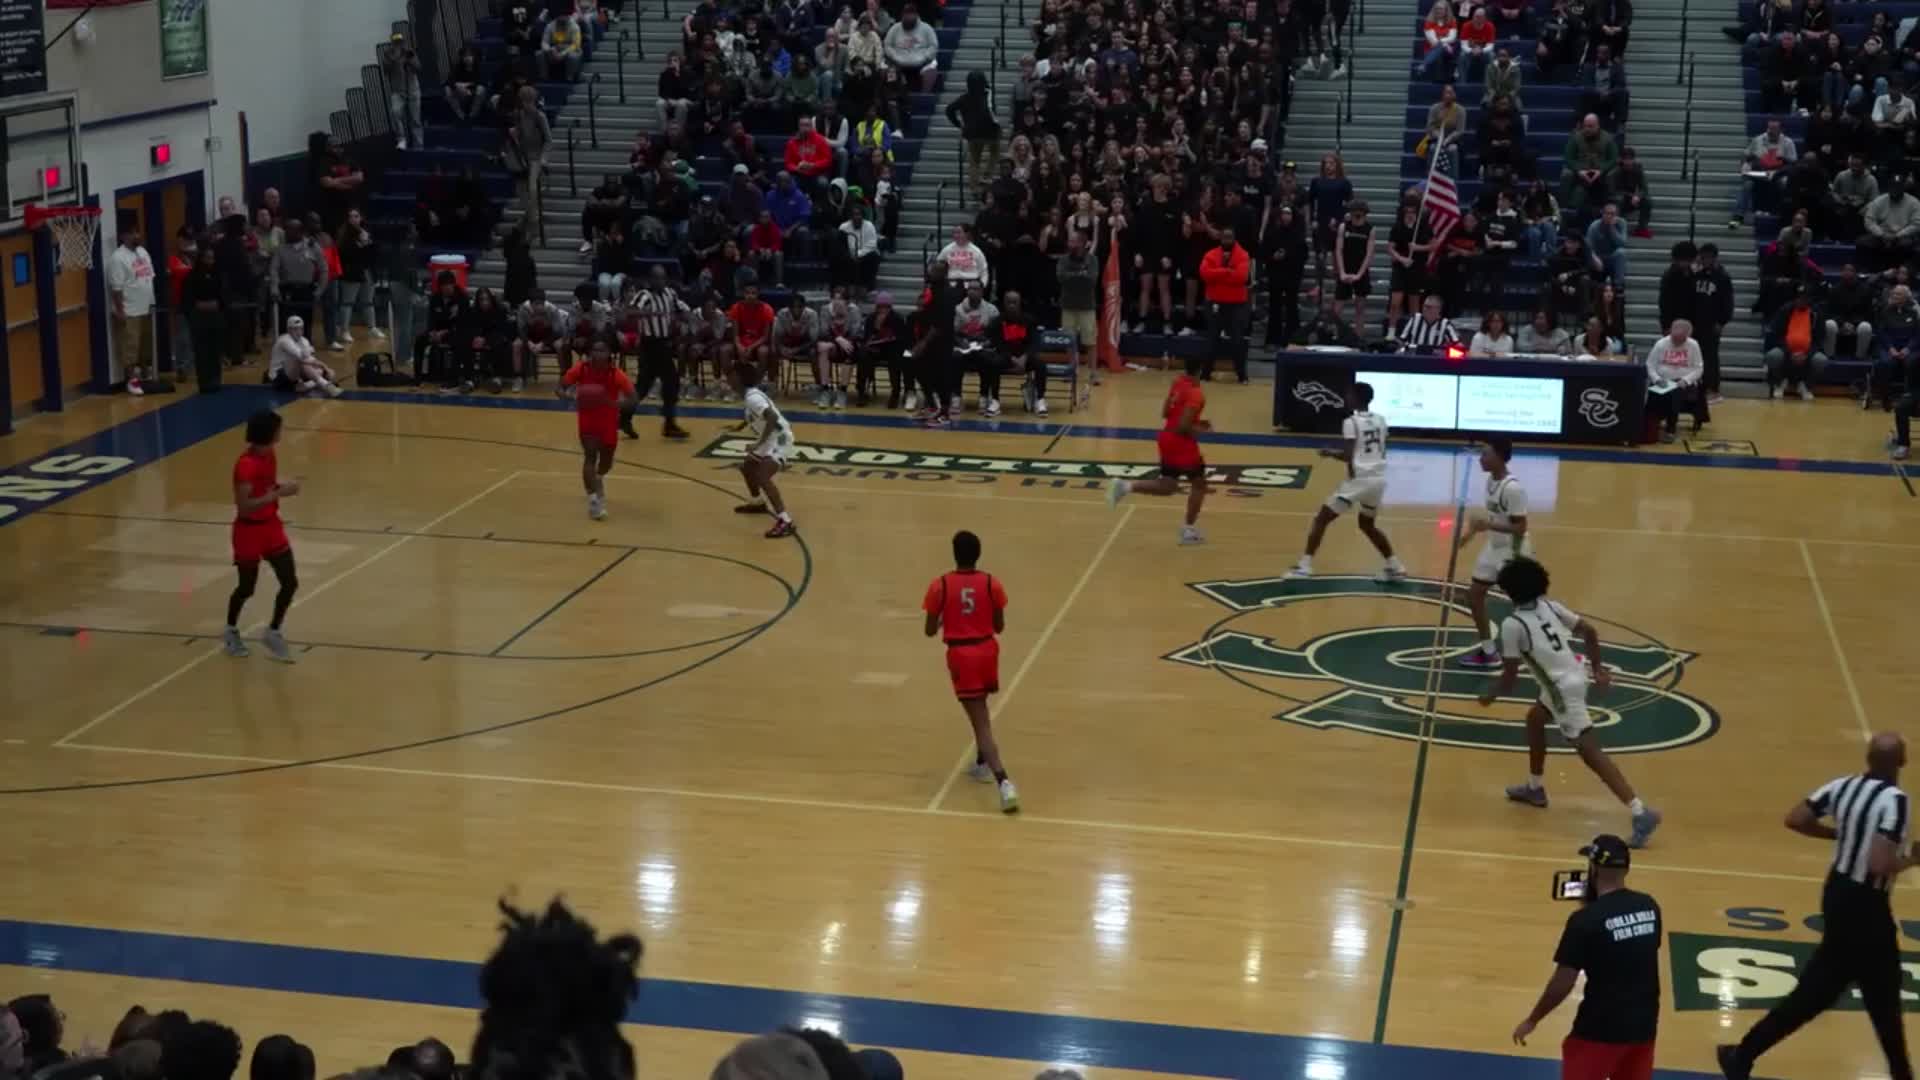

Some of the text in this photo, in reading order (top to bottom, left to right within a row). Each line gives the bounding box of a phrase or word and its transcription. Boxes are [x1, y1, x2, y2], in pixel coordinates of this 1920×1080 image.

[1020, 477, 1265, 498] STH
[960, 587, 977, 615] 5
[1541, 622, 1562, 652] 5
